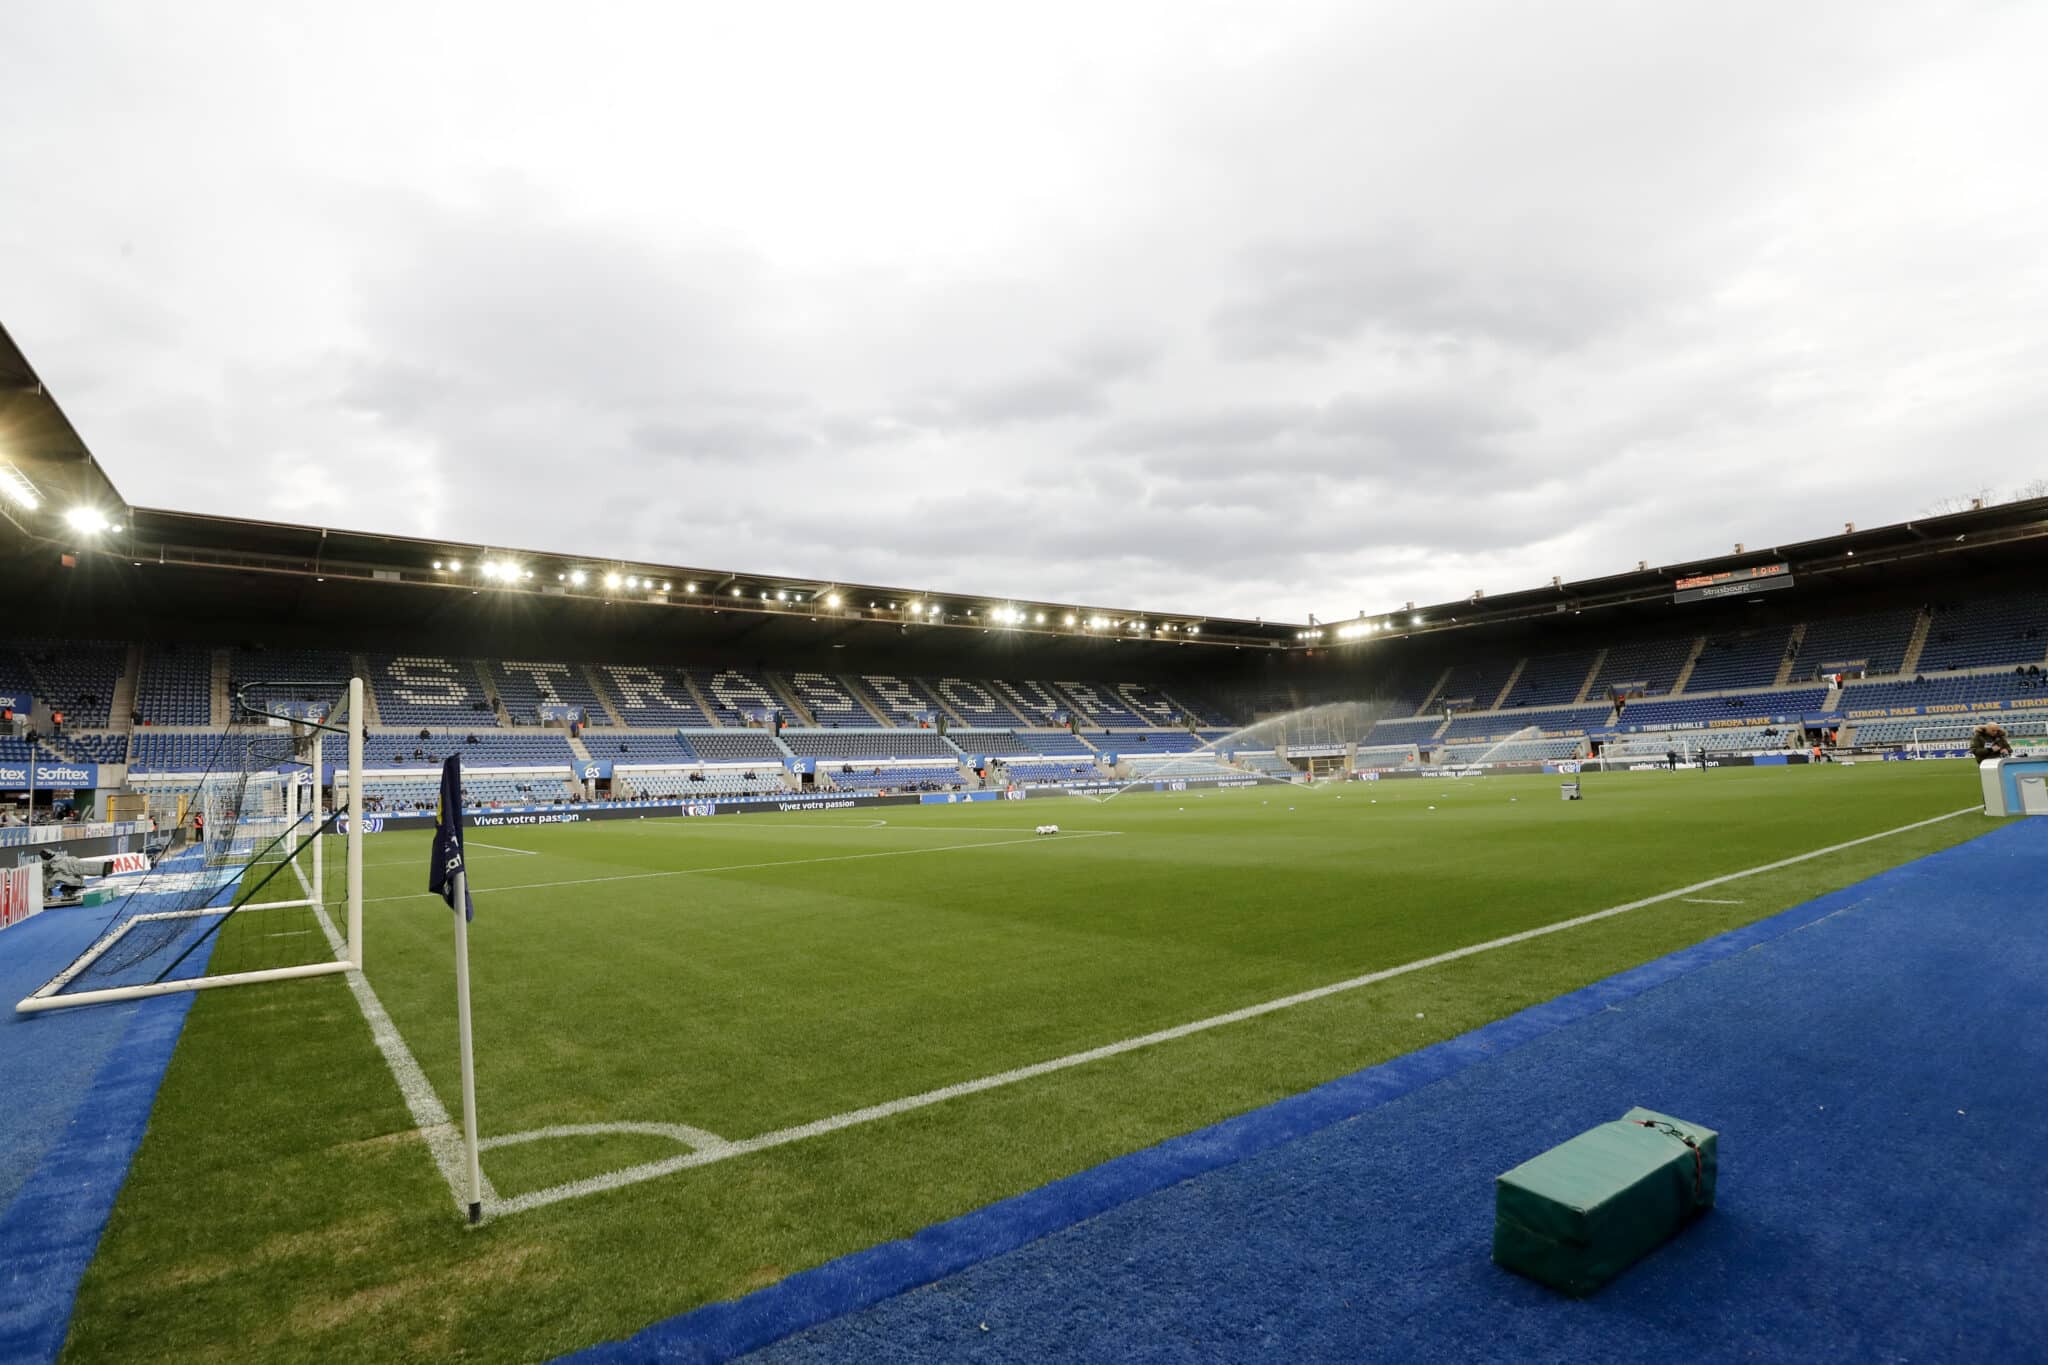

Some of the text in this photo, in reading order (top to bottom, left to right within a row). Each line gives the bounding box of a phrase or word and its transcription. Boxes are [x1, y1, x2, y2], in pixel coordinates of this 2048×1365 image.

[1849, 706, 1917, 720] EUROPA PARK
[1925, 701, 2001, 714] EUROPA PARK
[1642, 716, 1771, 732] TRIBUNE FAMILLE EUROPA PARK
[36, 767, 89, 780] Sofitex
[779, 802, 801, 811] Vivez
[825, 800, 855, 809] passion
[474, 816, 504, 826] Vivez
[507, 815, 536, 824] votre
